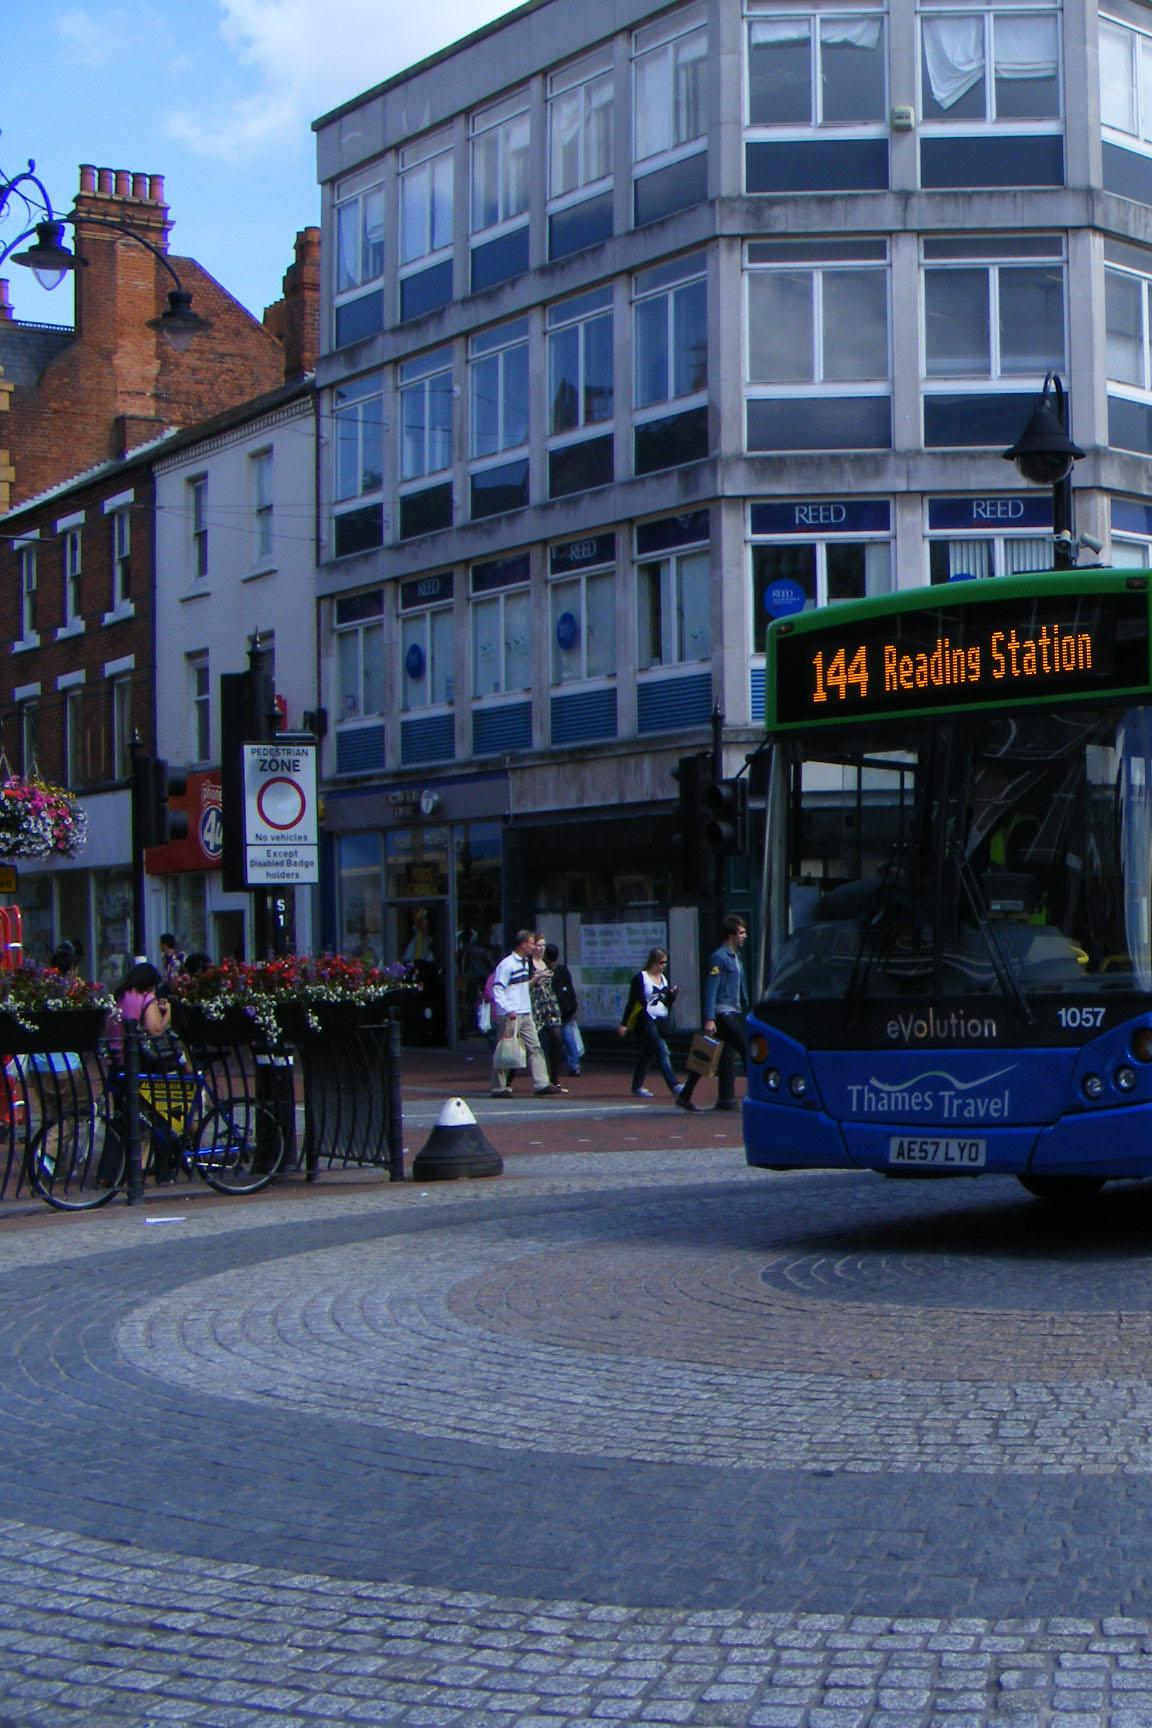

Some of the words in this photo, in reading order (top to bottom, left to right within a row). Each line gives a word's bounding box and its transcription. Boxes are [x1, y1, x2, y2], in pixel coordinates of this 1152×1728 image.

[795, 504, 847, 524] REED
[973, 499, 1024, 519] REED
[570, 539, 597, 561] REED
[417, 578, 440, 598] REED
[812, 645, 869, 703] 144
[884, 637, 981, 692] Reading
[991, 624, 1092, 680] Station
[250, 747, 309, 757] PEDESTRIAN
[259, 759, 301, 772] ZONE
[255, 833, 268, 842] No
[270, 833, 308, 842] vehicles
[250, 859, 285, 868] Disabled
[286, 859, 314, 869] Badge
[266, 849, 299, 859] Except
[265, 870, 300, 879] holders
[1056, 1007, 1106, 1028] 1057
[847, 1085, 934, 1113] Thames
[939, 1089, 1010, 1118] Travel
[896, 1140, 940, 1161] AE57
